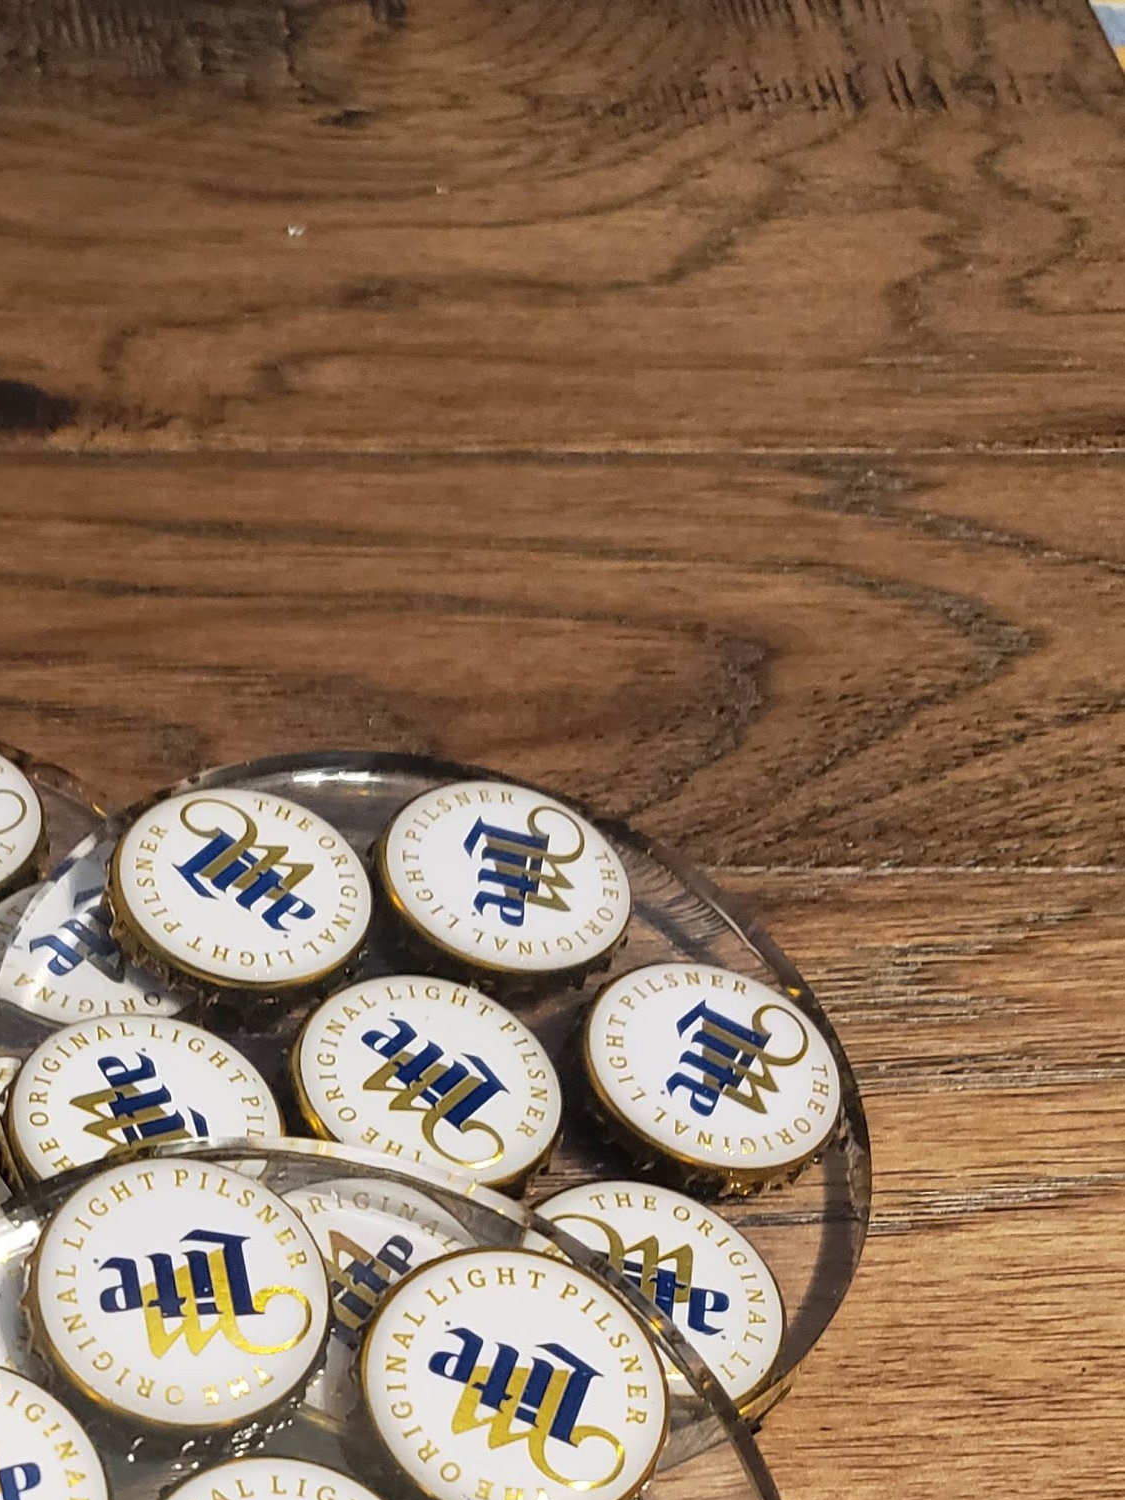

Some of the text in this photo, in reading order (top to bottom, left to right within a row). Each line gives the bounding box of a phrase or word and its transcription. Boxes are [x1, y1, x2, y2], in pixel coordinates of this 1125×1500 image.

[133, 797, 361, 969] THE ORIGINAL LIGHT PILSNER
[398, 787, 622, 958] THE ORIGINAL LIGHT PILSNER
[13, 972, 162, 1014] ORIGINA
[314, 994, 376, 1123] ORIGINAL
[383, 982, 495, 1018] LIGHT
[498, 1020, 551, 1140] PILSNER
[605, 969, 832, 1156] THE ORIGINAL LIGHT PILSNER
[29, 1020, 134, 1127] ORIGINAL
[149, 1021, 250, 1085] LIGHT
[61, 1169, 155, 1251] LIGHT
[173, 1167, 312, 1269] PILSNER
[588, 1191, 769, 1344] THE ORIGINAL
[54, 1264, 185, 1406] ORIGINAL
[383, 1311, 462, 1484] ORIGINAL
[424, 1266, 547, 1307] LIGHT
[558, 1282, 650, 1426] PILSNER
